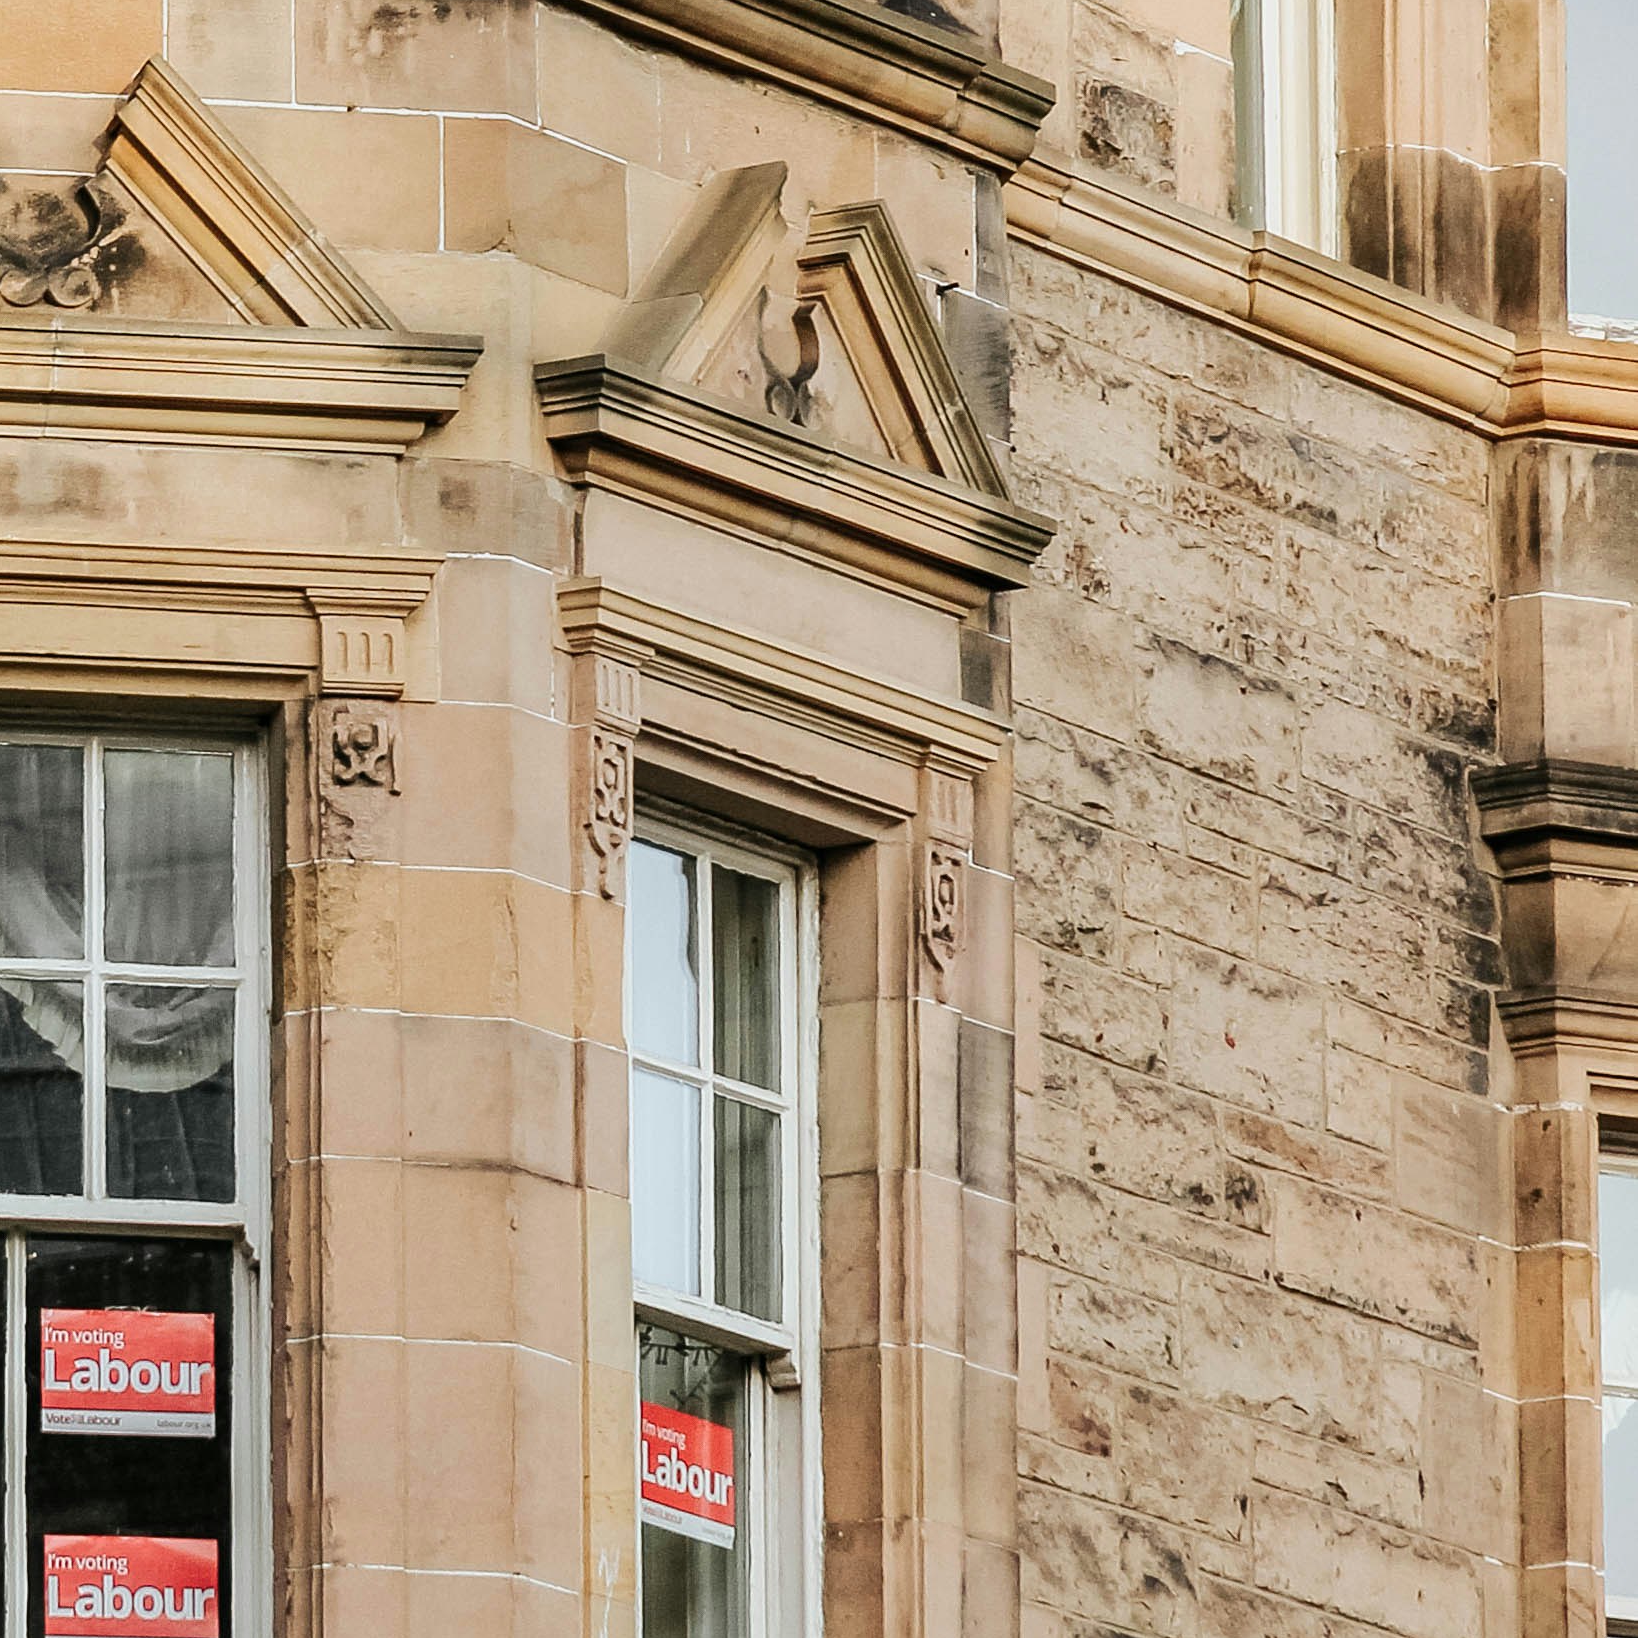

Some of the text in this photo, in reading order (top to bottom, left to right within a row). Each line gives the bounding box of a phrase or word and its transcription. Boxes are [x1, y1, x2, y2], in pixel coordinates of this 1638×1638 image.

[44, 1327, 125, 1349] I'm voting
[44, 1348, 212, 1395] Labour
[45, 1413, 121, 1426] Vote Labour
[657, 1427, 686, 1450] voting
[642, 1440, 732, 1506] Labour
[47, 1553, 128, 1575] I'm voting
[47, 1575, 215, 1620] Labour
